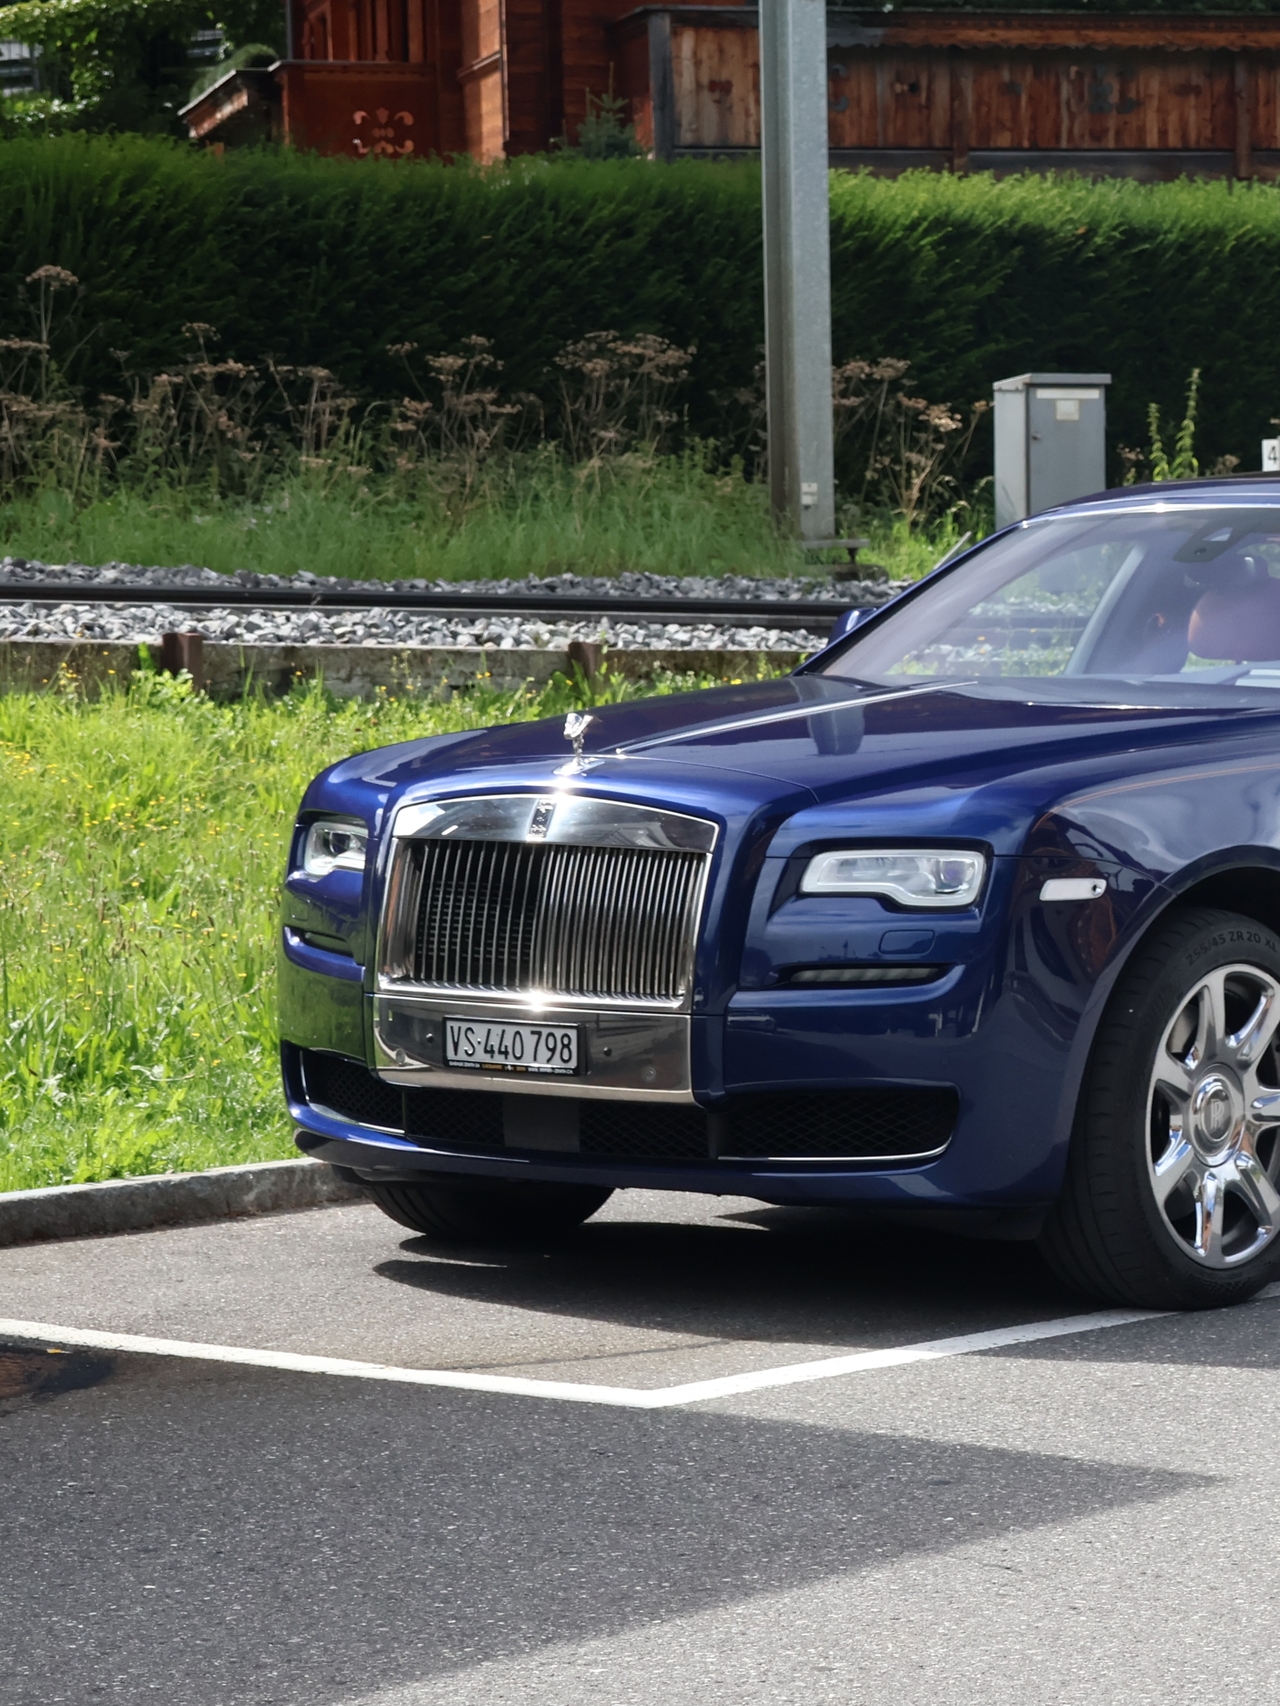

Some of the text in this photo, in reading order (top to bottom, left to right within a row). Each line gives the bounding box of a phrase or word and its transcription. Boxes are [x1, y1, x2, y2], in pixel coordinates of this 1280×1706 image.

[1267, 445, 1277, 464] 4
[1186, 933, 1226, 966] 255/45
[1264, 937, 1278, 953] XL
